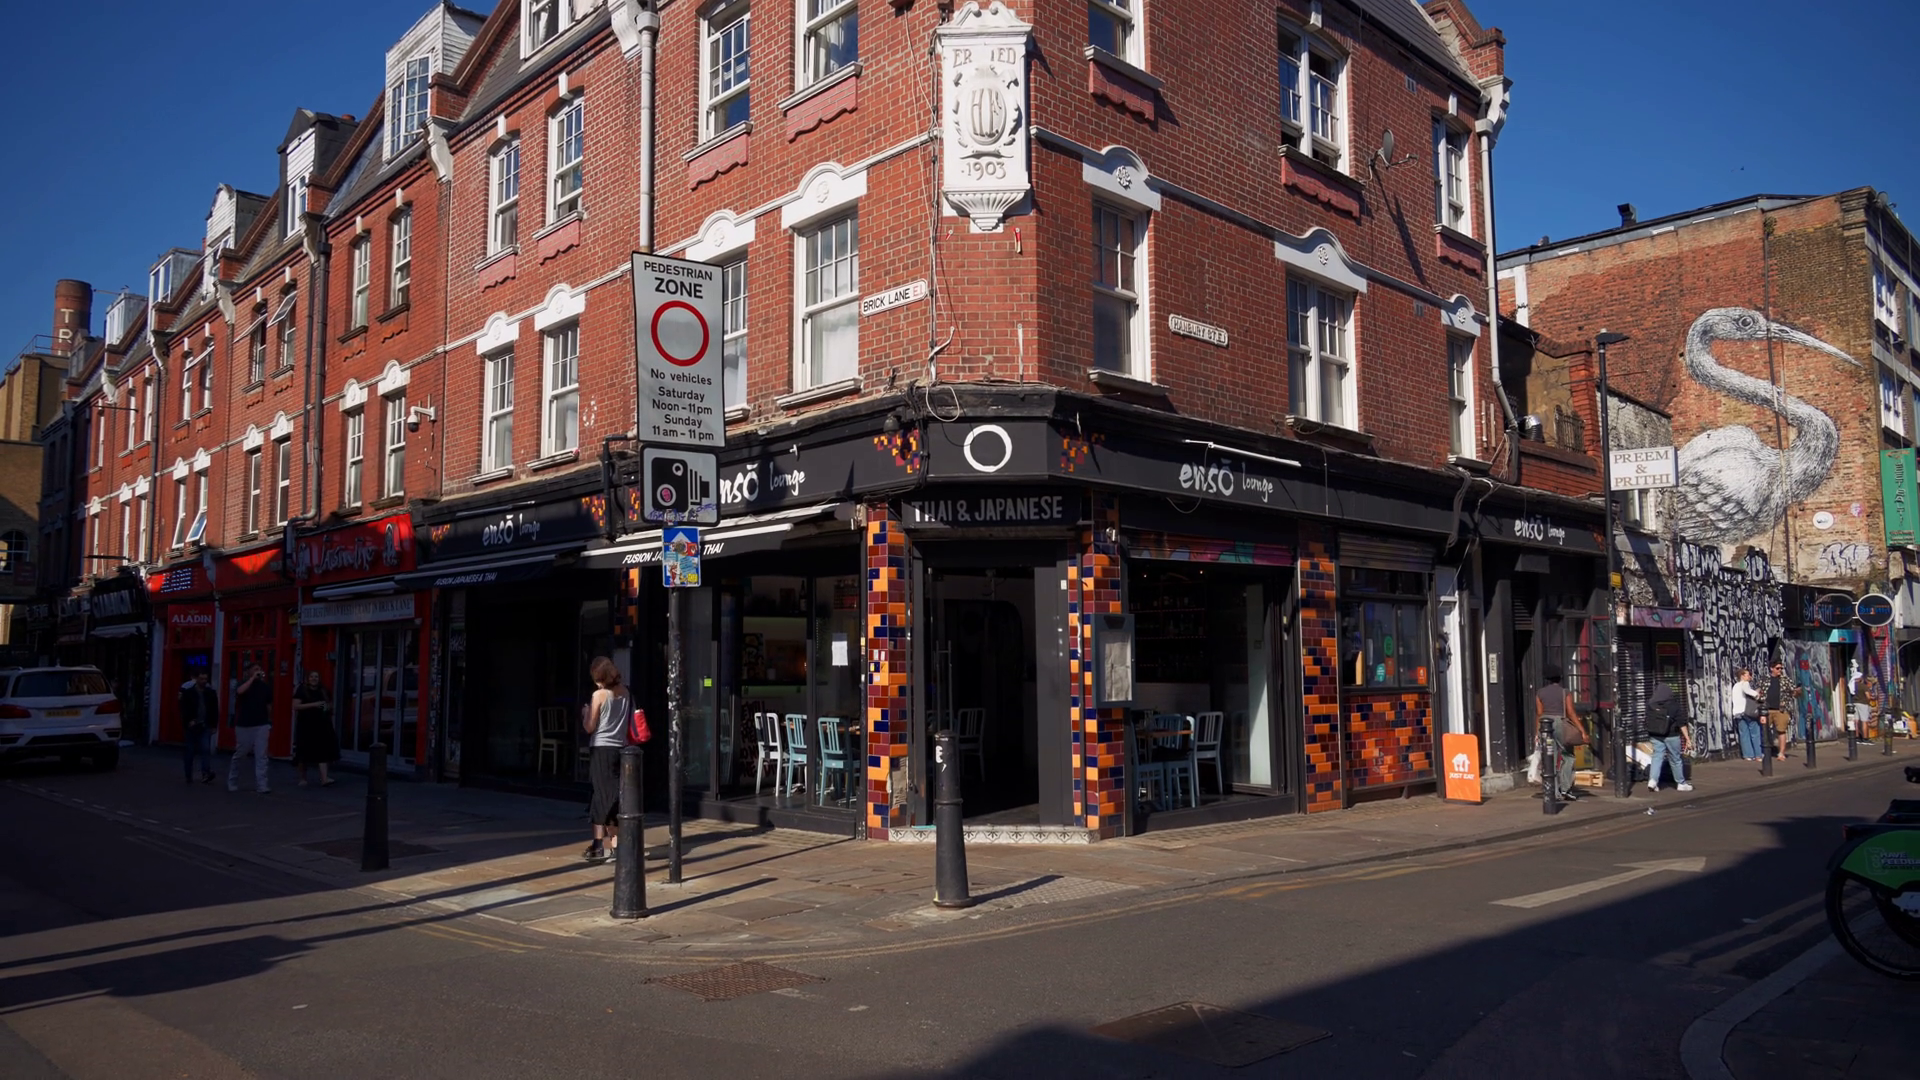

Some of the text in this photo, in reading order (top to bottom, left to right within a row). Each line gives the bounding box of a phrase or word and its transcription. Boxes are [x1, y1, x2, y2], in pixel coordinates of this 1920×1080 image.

[644, 261, 713, 281] PEDESTRIAN
[654, 277, 703, 299] ZONE
[863, 296, 886, 312] BRICK
[888, 288, 910, 305] LANE
[651, 368, 712, 386] No vehicles
[658, 386, 705, 403] Saturday
[652, 398, 680, 411] Noon
[664, 413, 703, 429] Sunday
[1614, 450, 1669, 464] PREEM
[769, 461, 806, 496] lounge
[1635, 464, 1647, 474] &
[1241, 461, 1274, 503] lounge
[1615, 474, 1671, 487] PRITHI
[911, 496, 1063, 522] THAI & JAPANESE
[519, 513, 541, 541] lounge
[622, 552, 652, 564] FUSION
[703, 543, 725, 556] THAI
[172, 614, 212, 623] ALADIN
